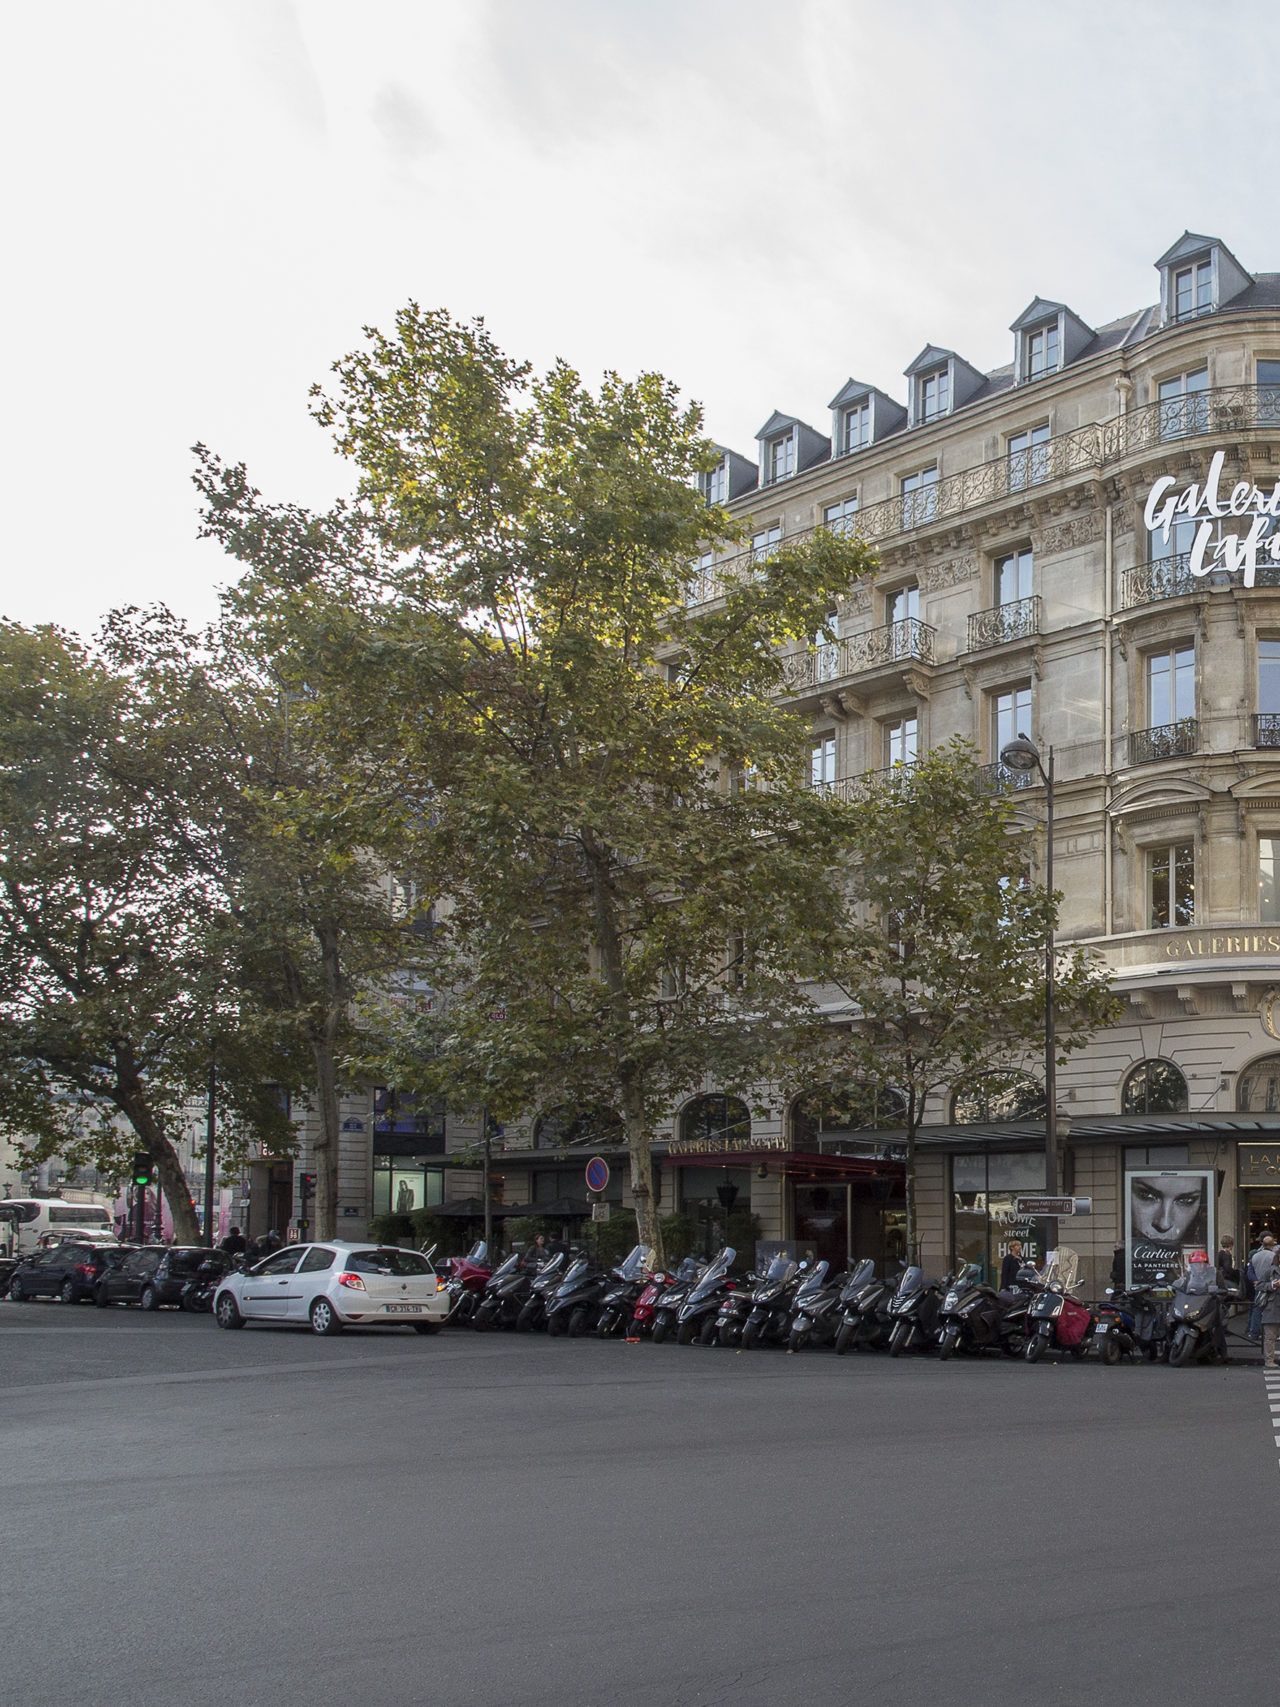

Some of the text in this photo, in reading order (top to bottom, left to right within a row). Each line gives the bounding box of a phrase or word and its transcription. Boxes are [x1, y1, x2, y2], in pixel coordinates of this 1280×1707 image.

[1166, 935, 1280, 957] GALERIES
[1250, 1154, 1270, 1164] LA
[1241, 1166, 1260, 1176] LE
[1004, 1228, 1029, 1237] sweet
[998, 1242, 1037, 1259] HME
[1133, 1244, 1179, 1259] Cartier
